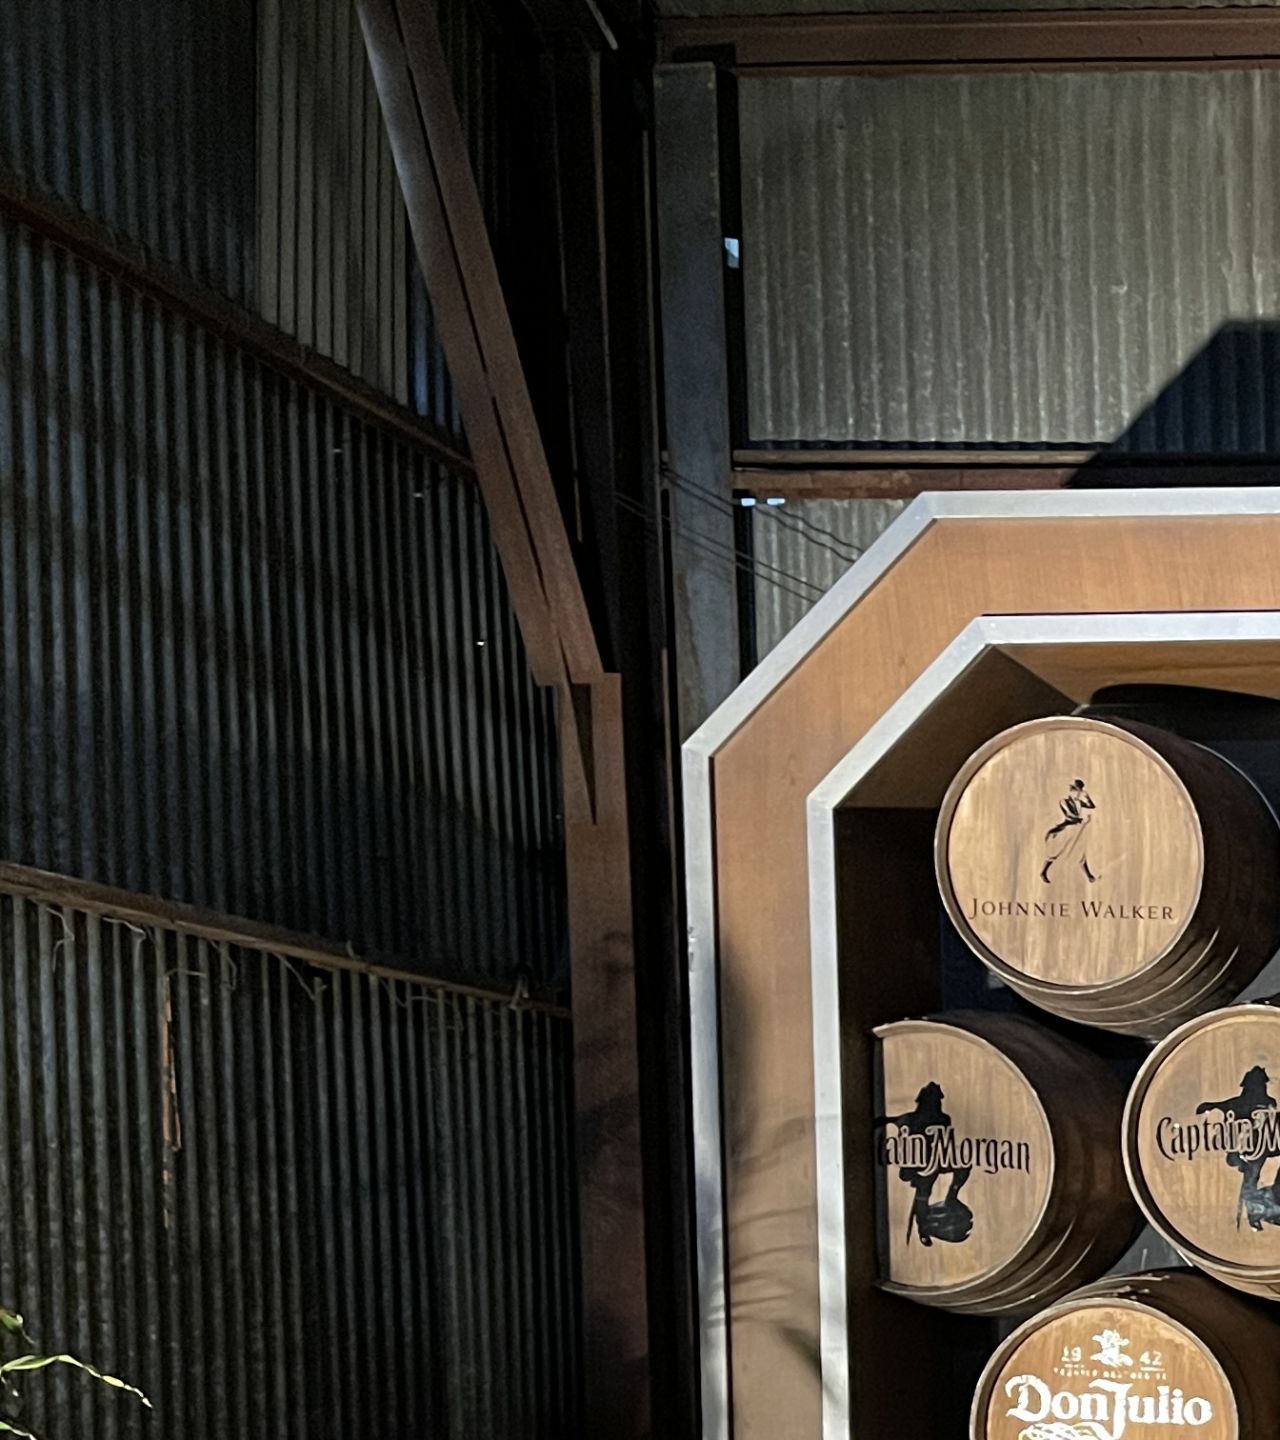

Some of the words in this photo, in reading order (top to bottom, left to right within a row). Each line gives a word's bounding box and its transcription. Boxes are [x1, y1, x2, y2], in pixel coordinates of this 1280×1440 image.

[969, 897, 1071, 920] JOHNNIE
[1081, 900, 1175, 920] WALKER
[916, 1124, 1031, 1175] Morgan
[1155, 1109, 1256, 1162] Captain
[1061, 1345, 1082, 1363] 19
[1139, 1350, 1165, 1367] 42
